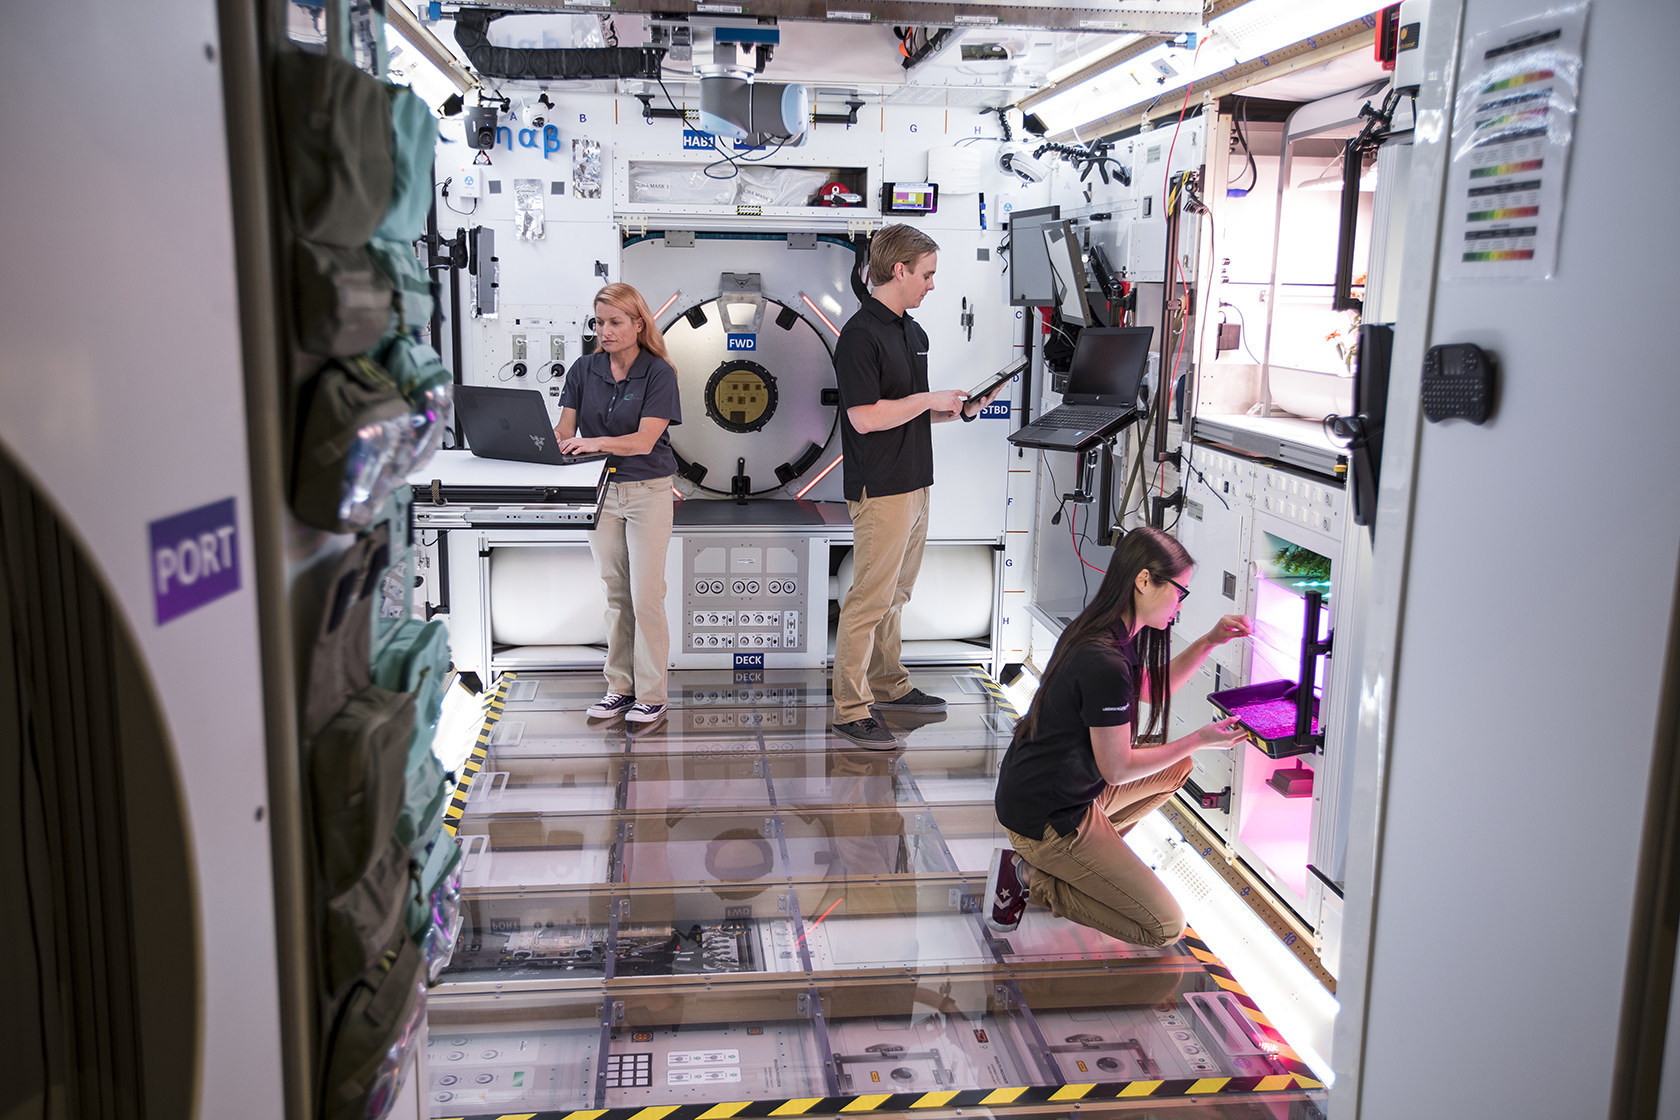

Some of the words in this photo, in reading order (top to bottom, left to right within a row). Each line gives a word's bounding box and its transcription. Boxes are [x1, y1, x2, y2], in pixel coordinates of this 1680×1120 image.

[509, 112, 518, 121] A
[579, 113, 587, 123] B
[909, 124, 918, 133] G
[974, 126, 982, 135] H
[1015, 310, 1023, 320] C
[729, 338, 754, 349] FWD
[981, 405, 1008, 415] STBD
[1007, 497, 1014, 506] F
[154, 525, 235, 595] PORT
[1005, 558, 1013, 567] G
[1002, 617, 1010, 625] H
[735, 655, 762, 665] DECK
[1169, 812, 1179, 821] 7
[1201, 847, 1212, 857] 8
[1239, 886, 1251, 897] 9
[1282, 931, 1297, 946] 10
